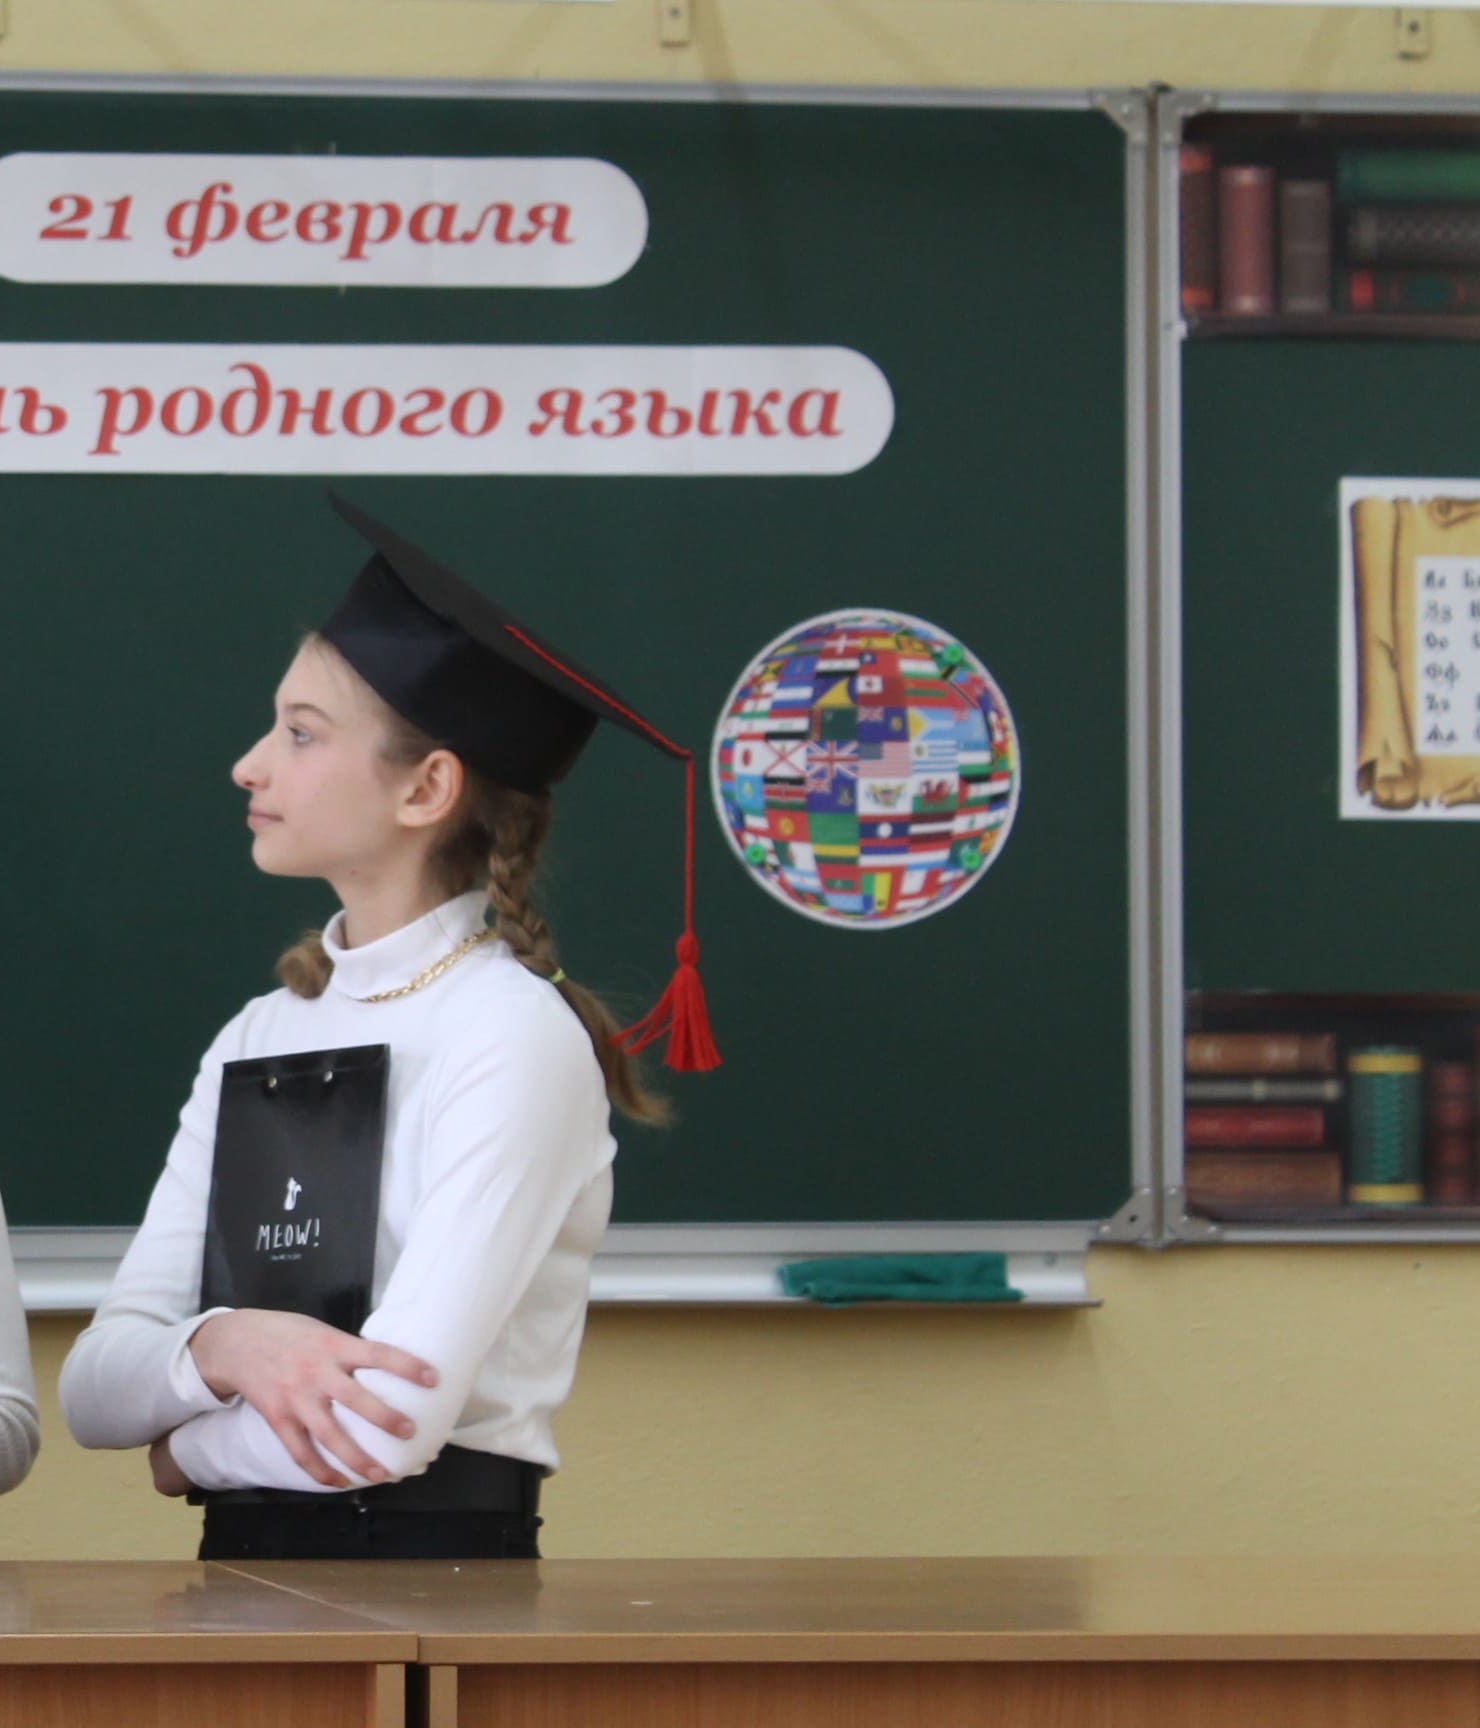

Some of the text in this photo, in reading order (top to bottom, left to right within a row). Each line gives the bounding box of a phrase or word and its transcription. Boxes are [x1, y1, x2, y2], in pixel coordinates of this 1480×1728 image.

[40, 182, 572, 261] 21 февраля
[91, 362, 505, 456] родного
[526, 388, 841, 438] языка
[255, 1217, 322, 1252] MEOW!
